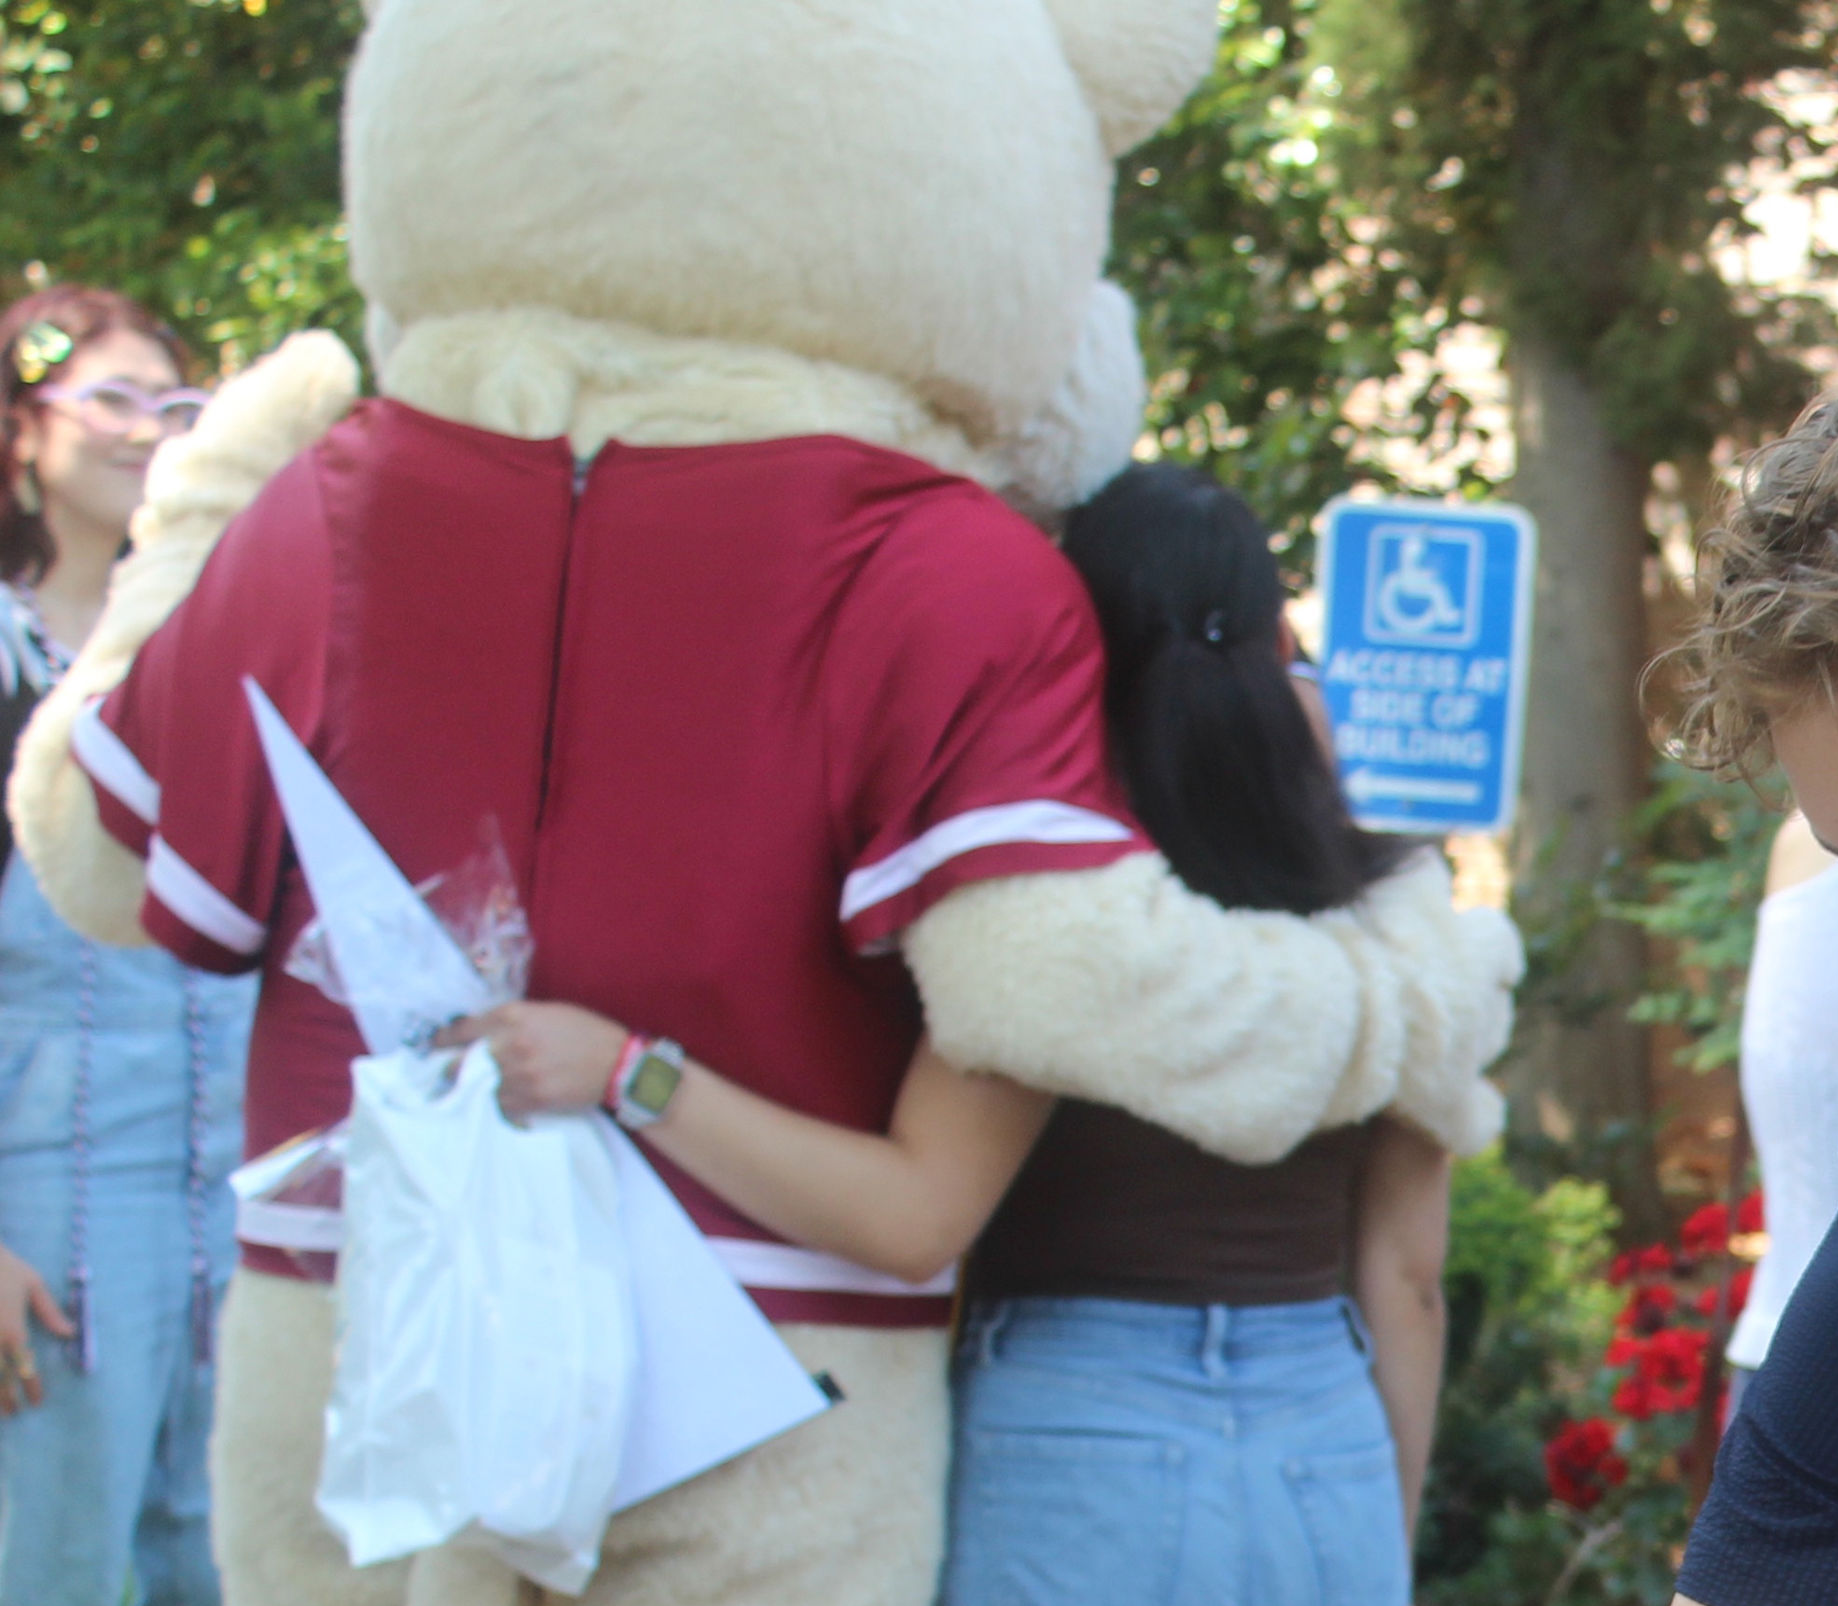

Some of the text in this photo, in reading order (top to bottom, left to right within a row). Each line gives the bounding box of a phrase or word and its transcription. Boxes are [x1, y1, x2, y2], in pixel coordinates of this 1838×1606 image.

[1327, 649, 1507, 692] ACCESS AT
[1350, 688, 1478, 728] SIDE OF
[1335, 724, 1490, 769] BUILDING
